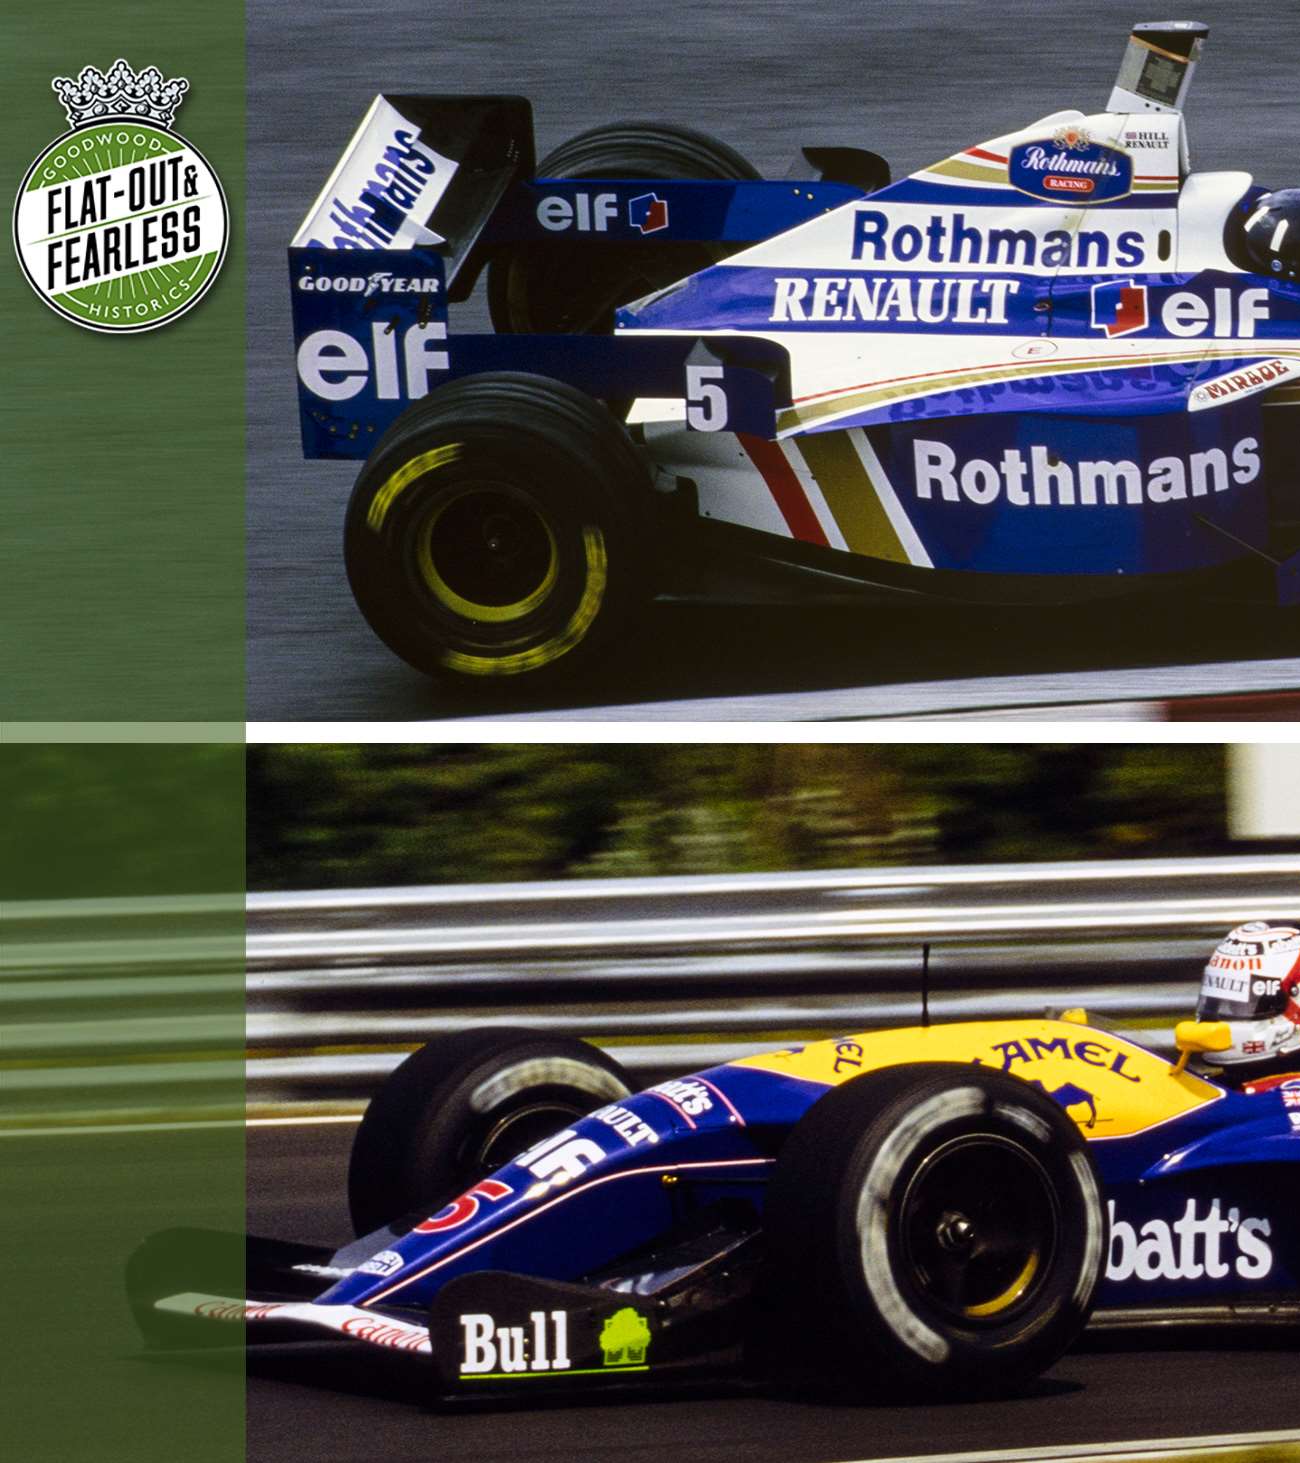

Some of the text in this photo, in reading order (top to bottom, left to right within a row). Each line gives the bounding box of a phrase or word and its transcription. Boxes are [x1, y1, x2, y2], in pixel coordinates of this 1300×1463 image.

[1124, 141, 1169, 149] RENAULT
[1138, 132, 1169, 141] HILL
[1020, 146, 1122, 177] Rothmans
[1049, 179, 1089, 190] RACING
[536, 193, 618, 232] elf
[851, 209, 1145, 268] Rothmans
[298, 272, 440, 297] GOODYEAR
[768, 277, 1021, 324] RENAULT
[1161, 287, 1270, 337] elf
[297, 321, 450, 400] elf
[684, 364, 729, 432] 5
[911, 436, 1262, 507] Rothmans
[1252, 979, 1281, 997] elf
[972, 1037, 1141, 1083] AMEL
[459, 1310, 571, 1375] Bull
